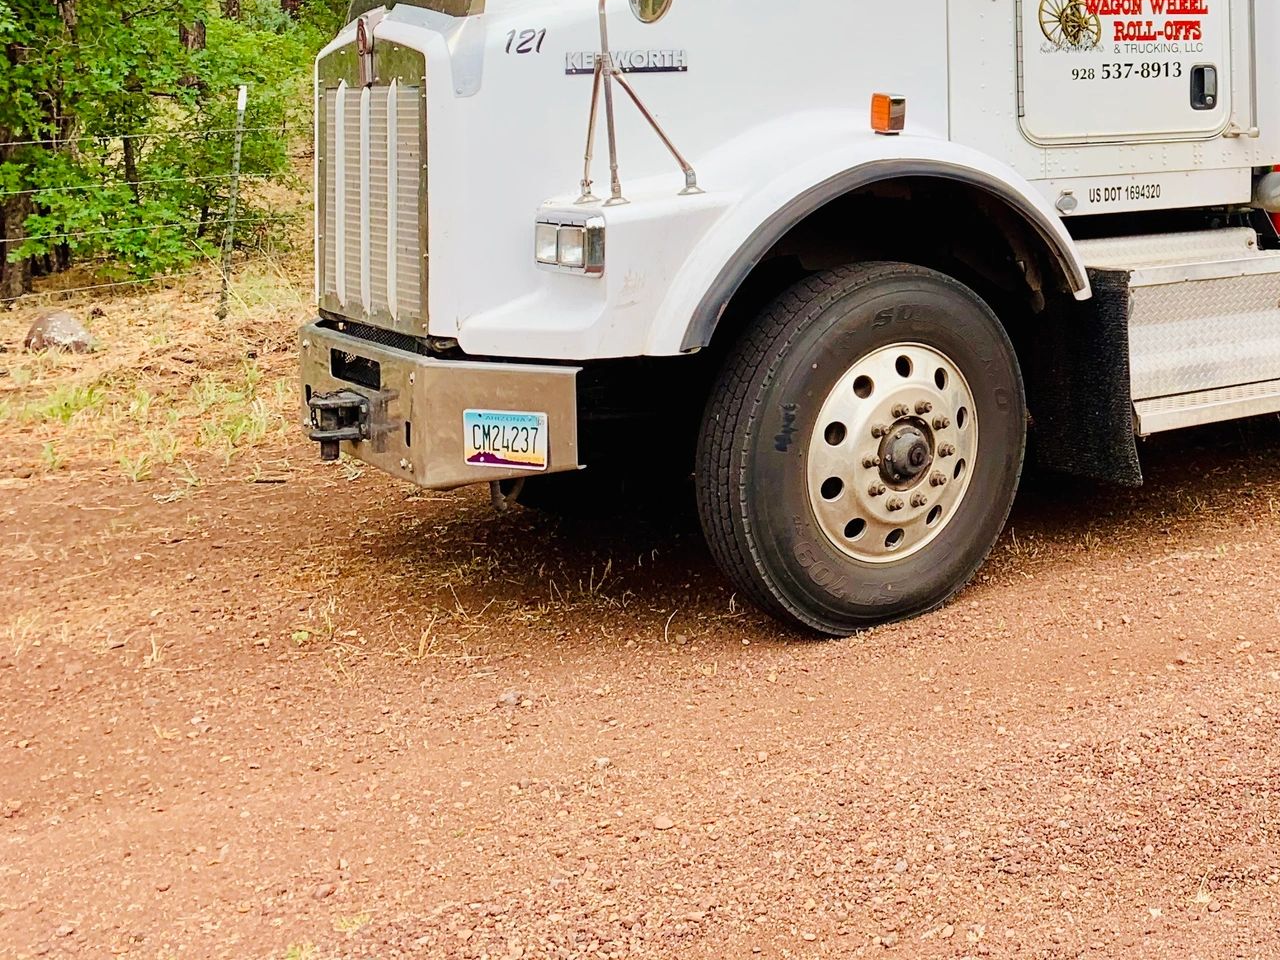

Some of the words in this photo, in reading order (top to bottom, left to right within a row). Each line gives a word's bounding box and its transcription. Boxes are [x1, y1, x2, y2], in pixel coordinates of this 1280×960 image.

[505, 27, 547, 54] 121
[1113, 20, 1203, 42] ROLL-OFFS
[1113, 44, 1121, 54] &
[1185, 42, 1204, 53] LLC
[1071, 68, 1096, 80] 928
[1101, 61, 1182, 80] 537-8913
[1089, 188, 1101, 203] US
[1104, 186, 1122, 202] DOT
[1125, 184, 1161, 200] 1694320
[472, 423, 539, 454] CM24237
